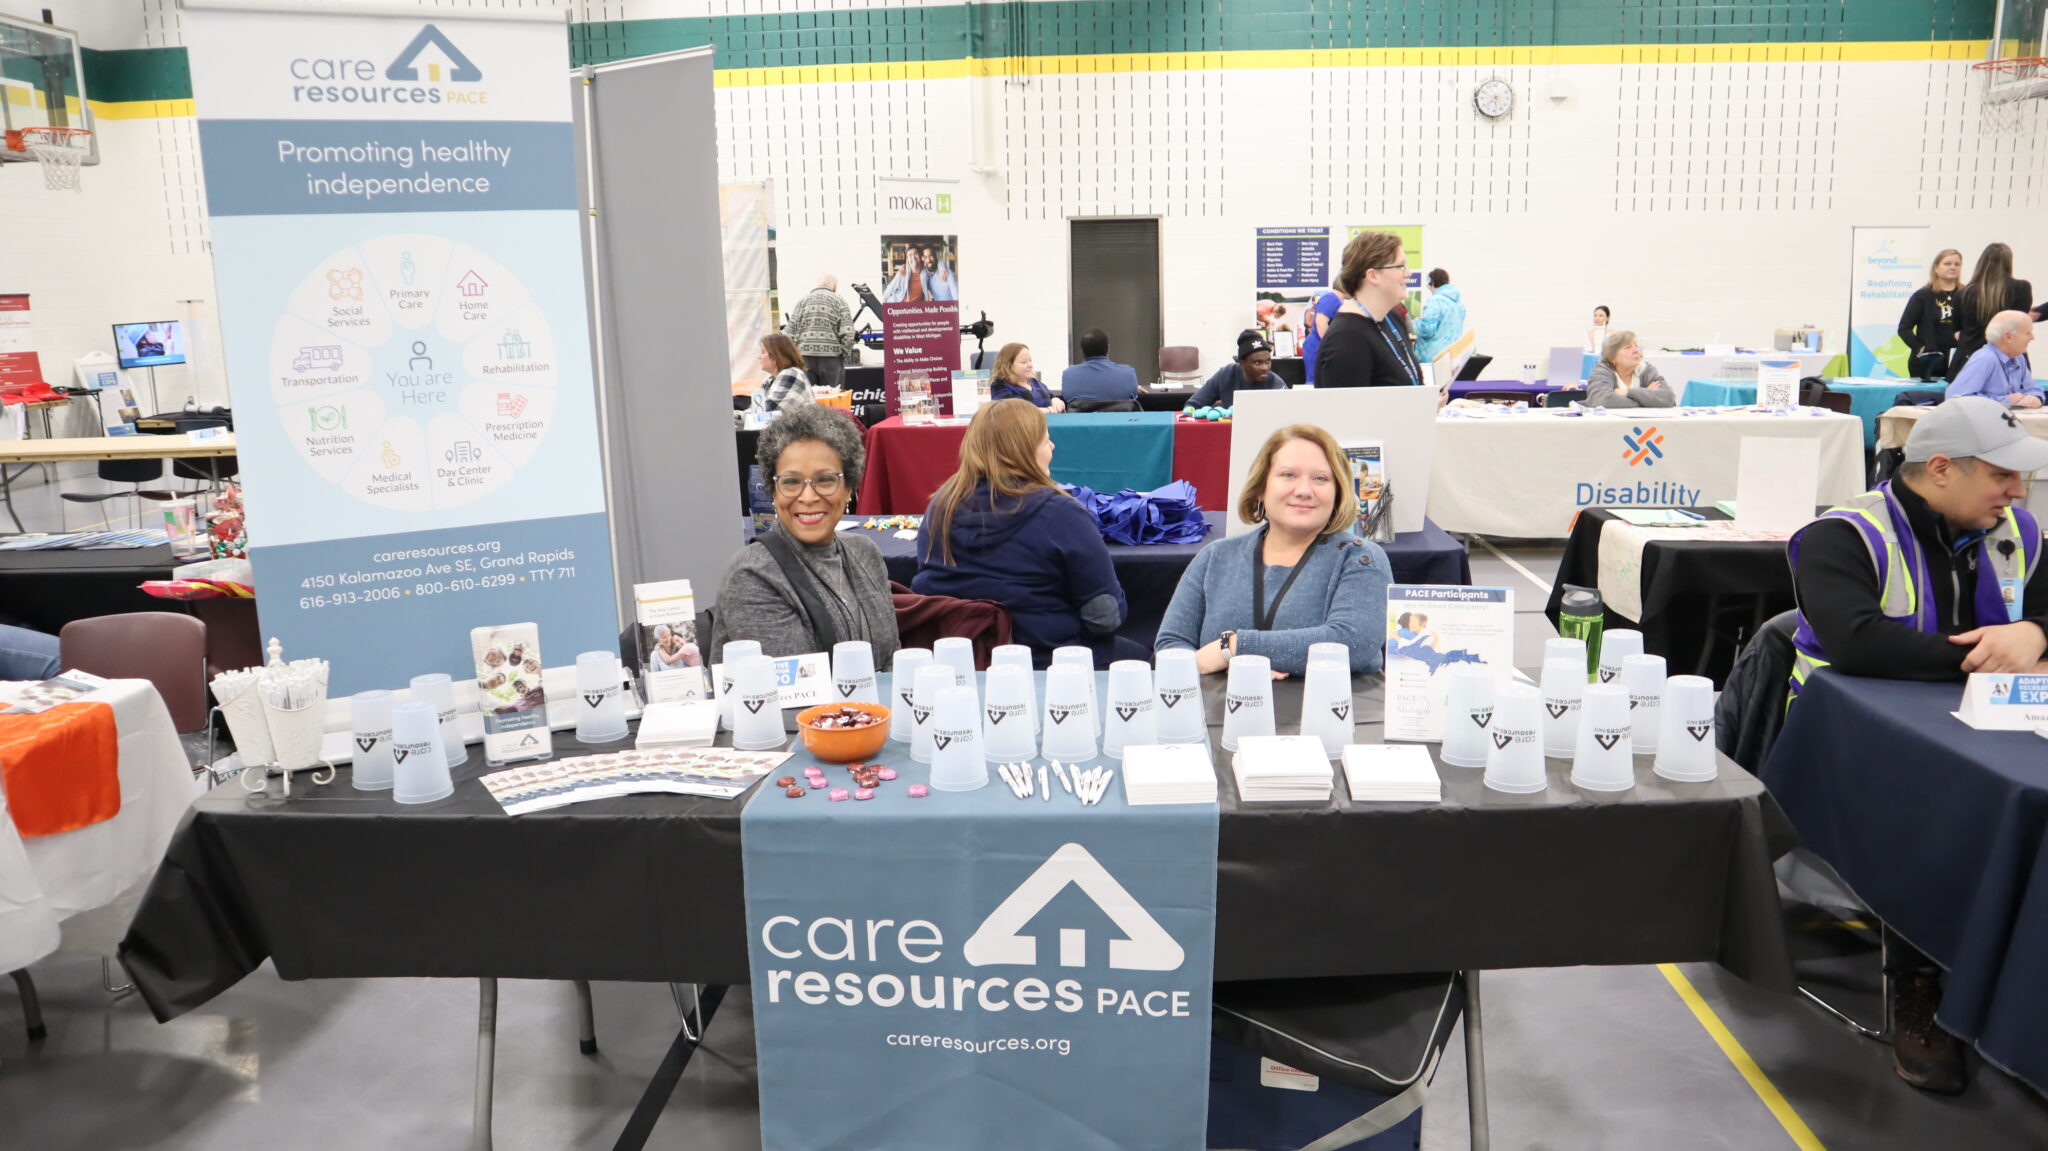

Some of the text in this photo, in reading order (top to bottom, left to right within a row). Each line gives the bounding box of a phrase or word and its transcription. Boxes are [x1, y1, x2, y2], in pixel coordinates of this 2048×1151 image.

[290, 58, 375, 81] care
[293, 84, 487, 105] resources PACE
[278, 139, 511, 168] Promoting healthy
[307, 173, 490, 199] independence
[1868, 280, 1912, 288] Redefining
[390, 289, 429, 299] Primary
[1860, 291, 1911, 299] Rehabilitati
[399, 300, 422, 309] Care
[459, 301, 488, 310] Home
[333, 306, 363, 316] Social
[463, 311, 486, 320] Care
[328, 317, 370, 327] Services
[483, 362, 549, 374] Rehabilitation
[281, 374, 358, 388] Transportation
[386, 372, 452, 387] You are
[402, 389, 446, 405] Here
[486, 420, 543, 432] Prescription
[306, 434, 354, 446] Nutrition
[493, 430, 537, 442] Medicine
[310, 446, 353, 457] Services
[372, 472, 411, 483] Medical
[437, 464, 491, 479] Day Center
[457, 475, 484, 486] Clinic
[367, 482, 419, 495] Specialists
[1577, 481, 1700, 506] Disability
[373, 540, 500, 563] careresources.org
[301, 548, 574, 588] 4150 Kalamazoo Ave SE, Grand Rapids
[300, 566, 575, 609] 616-913-2006 800-610-6299 TTY 711
[1405, 590, 1488, 600] PACE Participants
[2020, 692, 2048, 702] EXP
[411, 747, 431, 755] care
[762, 916, 943, 964] care
[767, 969, 1190, 1017] resources PACE
[886, 1032, 1071, 1055] careresources.org
